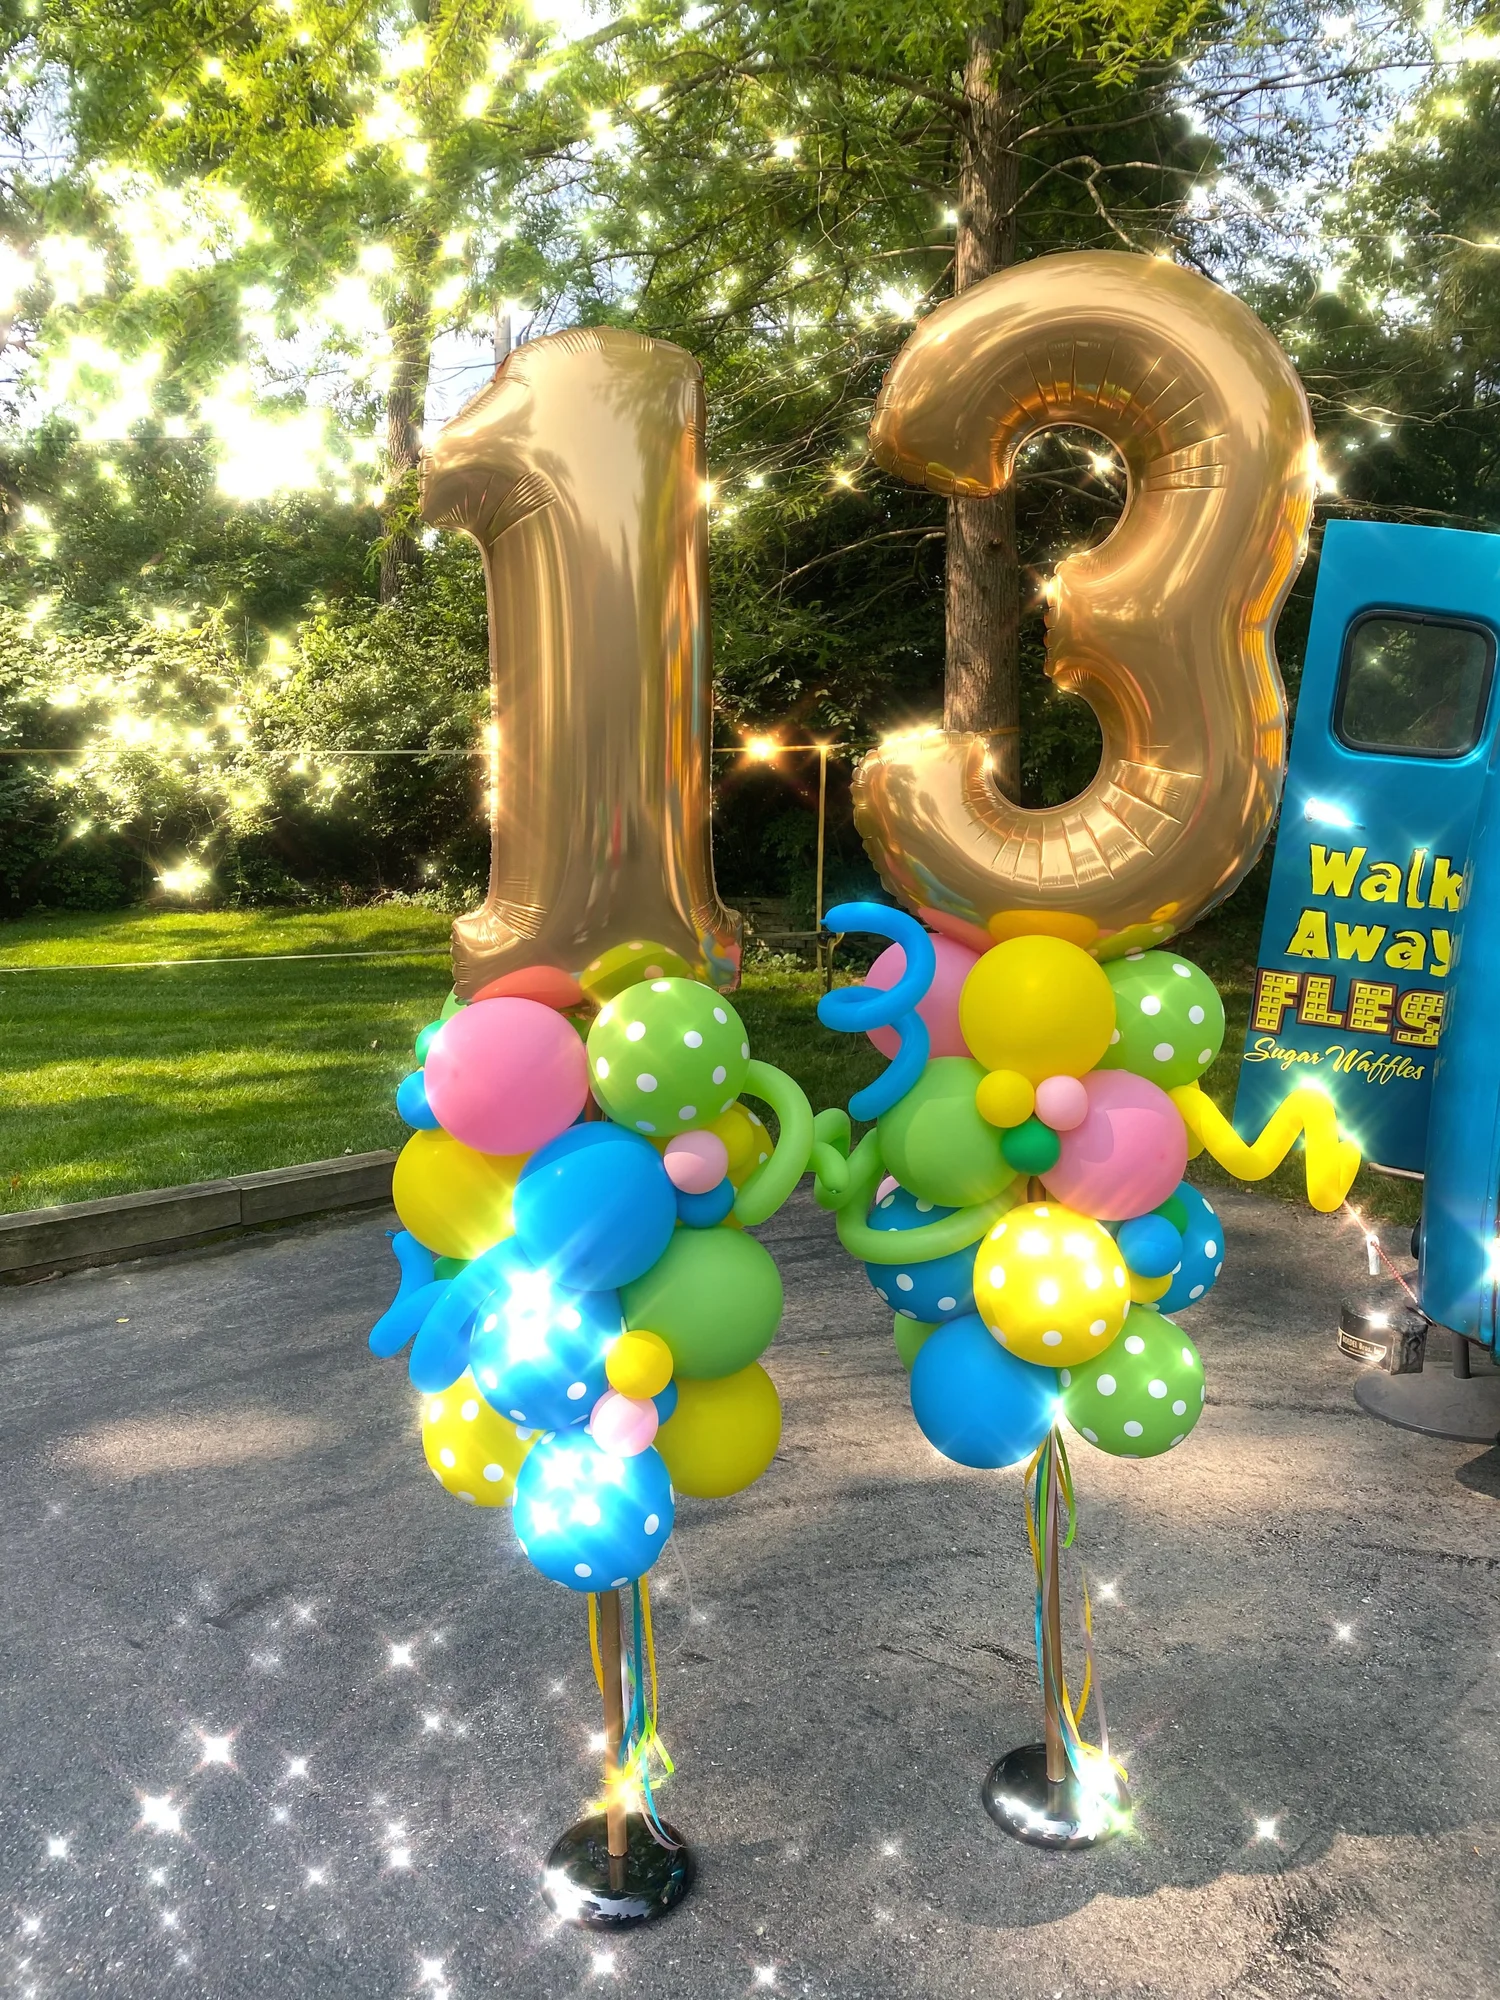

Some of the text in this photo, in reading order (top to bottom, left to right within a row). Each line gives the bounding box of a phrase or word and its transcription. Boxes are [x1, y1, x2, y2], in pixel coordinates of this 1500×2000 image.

[1310, 843, 1463, 912] Walk
[1284, 907, 1451, 977] Away
[1250, 968, 1444, 1048] FLES
[1244, 1036, 1425, 1085] Sugar Waffles
